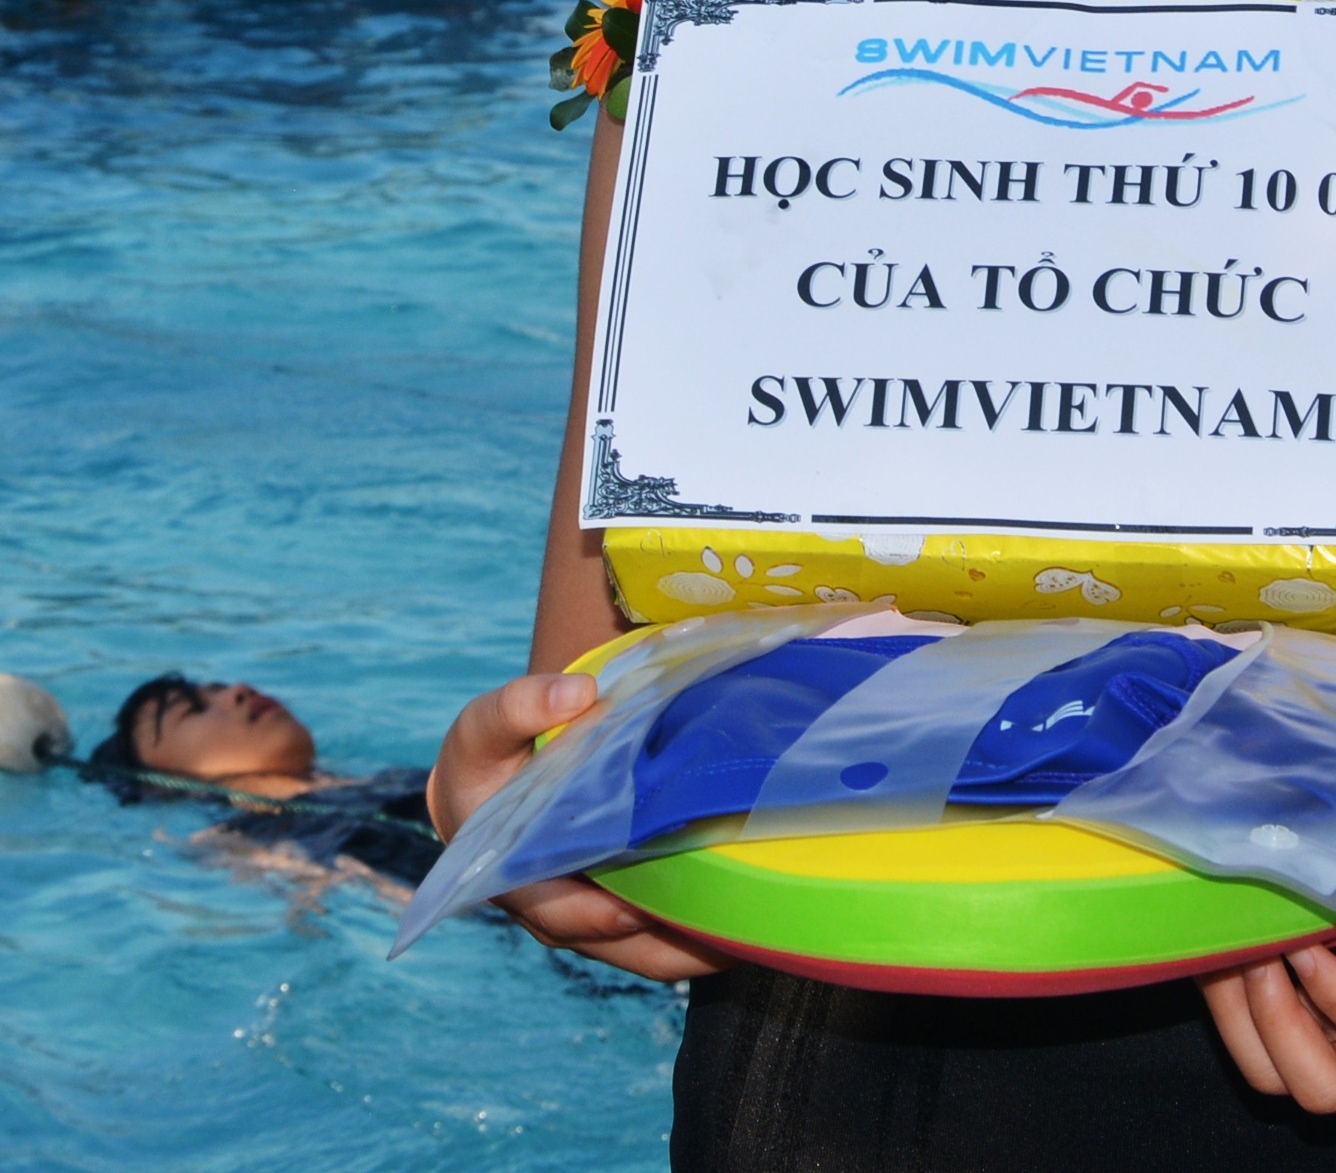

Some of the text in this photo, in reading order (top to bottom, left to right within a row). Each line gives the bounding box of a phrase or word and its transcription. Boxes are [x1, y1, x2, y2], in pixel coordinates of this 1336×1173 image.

[711, 155, 862, 210] HỌC
[879, 158, 1041, 204] SINH
[1063, 153, 1220, 209] THỨ
[1236, 168, 1298, 213] 10
[796, 247, 1310, 324] CỦA TỔ CHỨC
[747, 375, 1336, 444] SWIMVIETNAM
